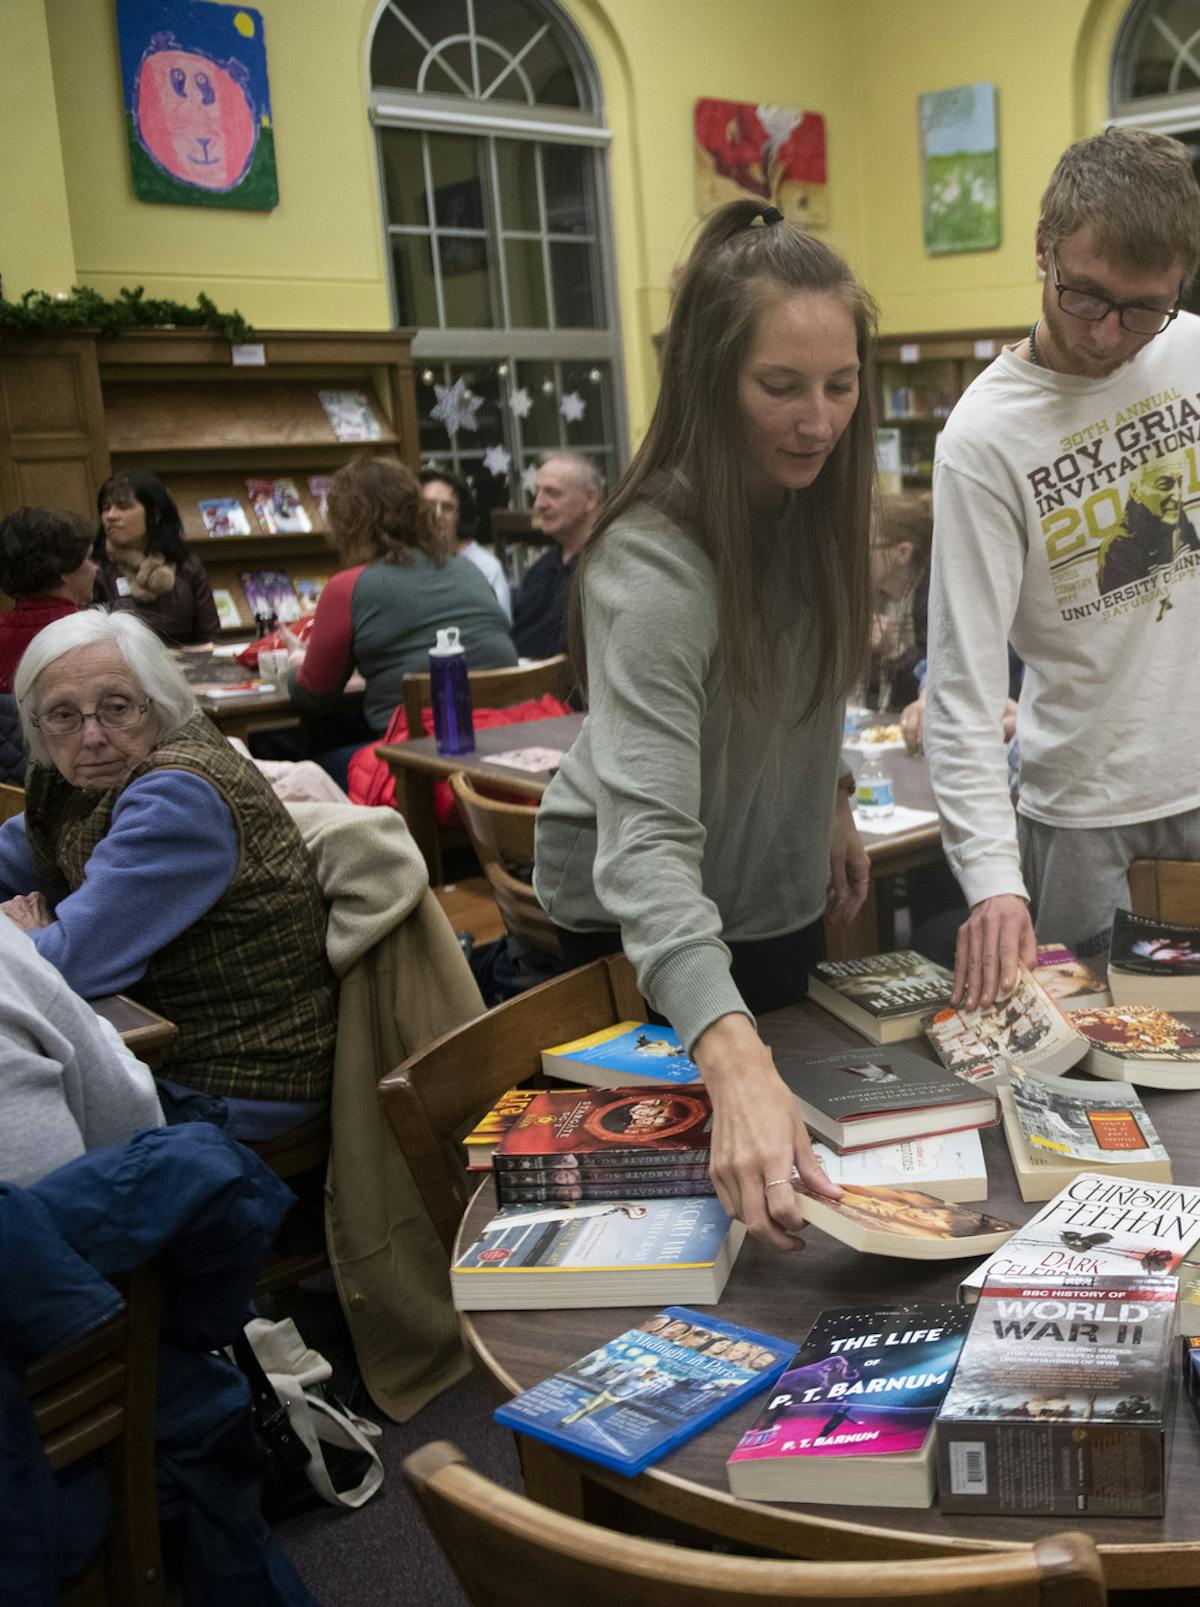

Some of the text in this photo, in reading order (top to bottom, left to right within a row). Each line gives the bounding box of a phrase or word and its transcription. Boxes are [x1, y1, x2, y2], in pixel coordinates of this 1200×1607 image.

[1060, 387, 1181, 452] 30TH ANNUAL
[1027, 438, 1103, 498] ROY
[1040, 488, 1123, 562] 20
[1060, 576, 1158, 622] UNIVERSITY
[870, 988, 952, 1009] EPHEN
[623, 1169, 688, 1180] STARGATE
[622, 1185, 688, 1197] STARGATE
[655, 1199, 706, 1262] SECRET LIFE
[1034, 1200, 1199, 1241] FEEHAN
[1040, 1251, 1109, 1275] DARK
[1022, 1289, 1126, 1299] BBC HISTORY OF
[994, 1300, 1150, 1323] WORLD
[829, 1327, 945, 1354] THE LIFE
[992, 1320, 1144, 1345] WAR II
[632, 1332, 737, 1379] Midnight in Paris
[863, 1359, 882, 1368] OF
[768, 1371, 949, 1410] P. T. BARNUM
[781, 1430, 881, 1451] P. T. BARNUM
